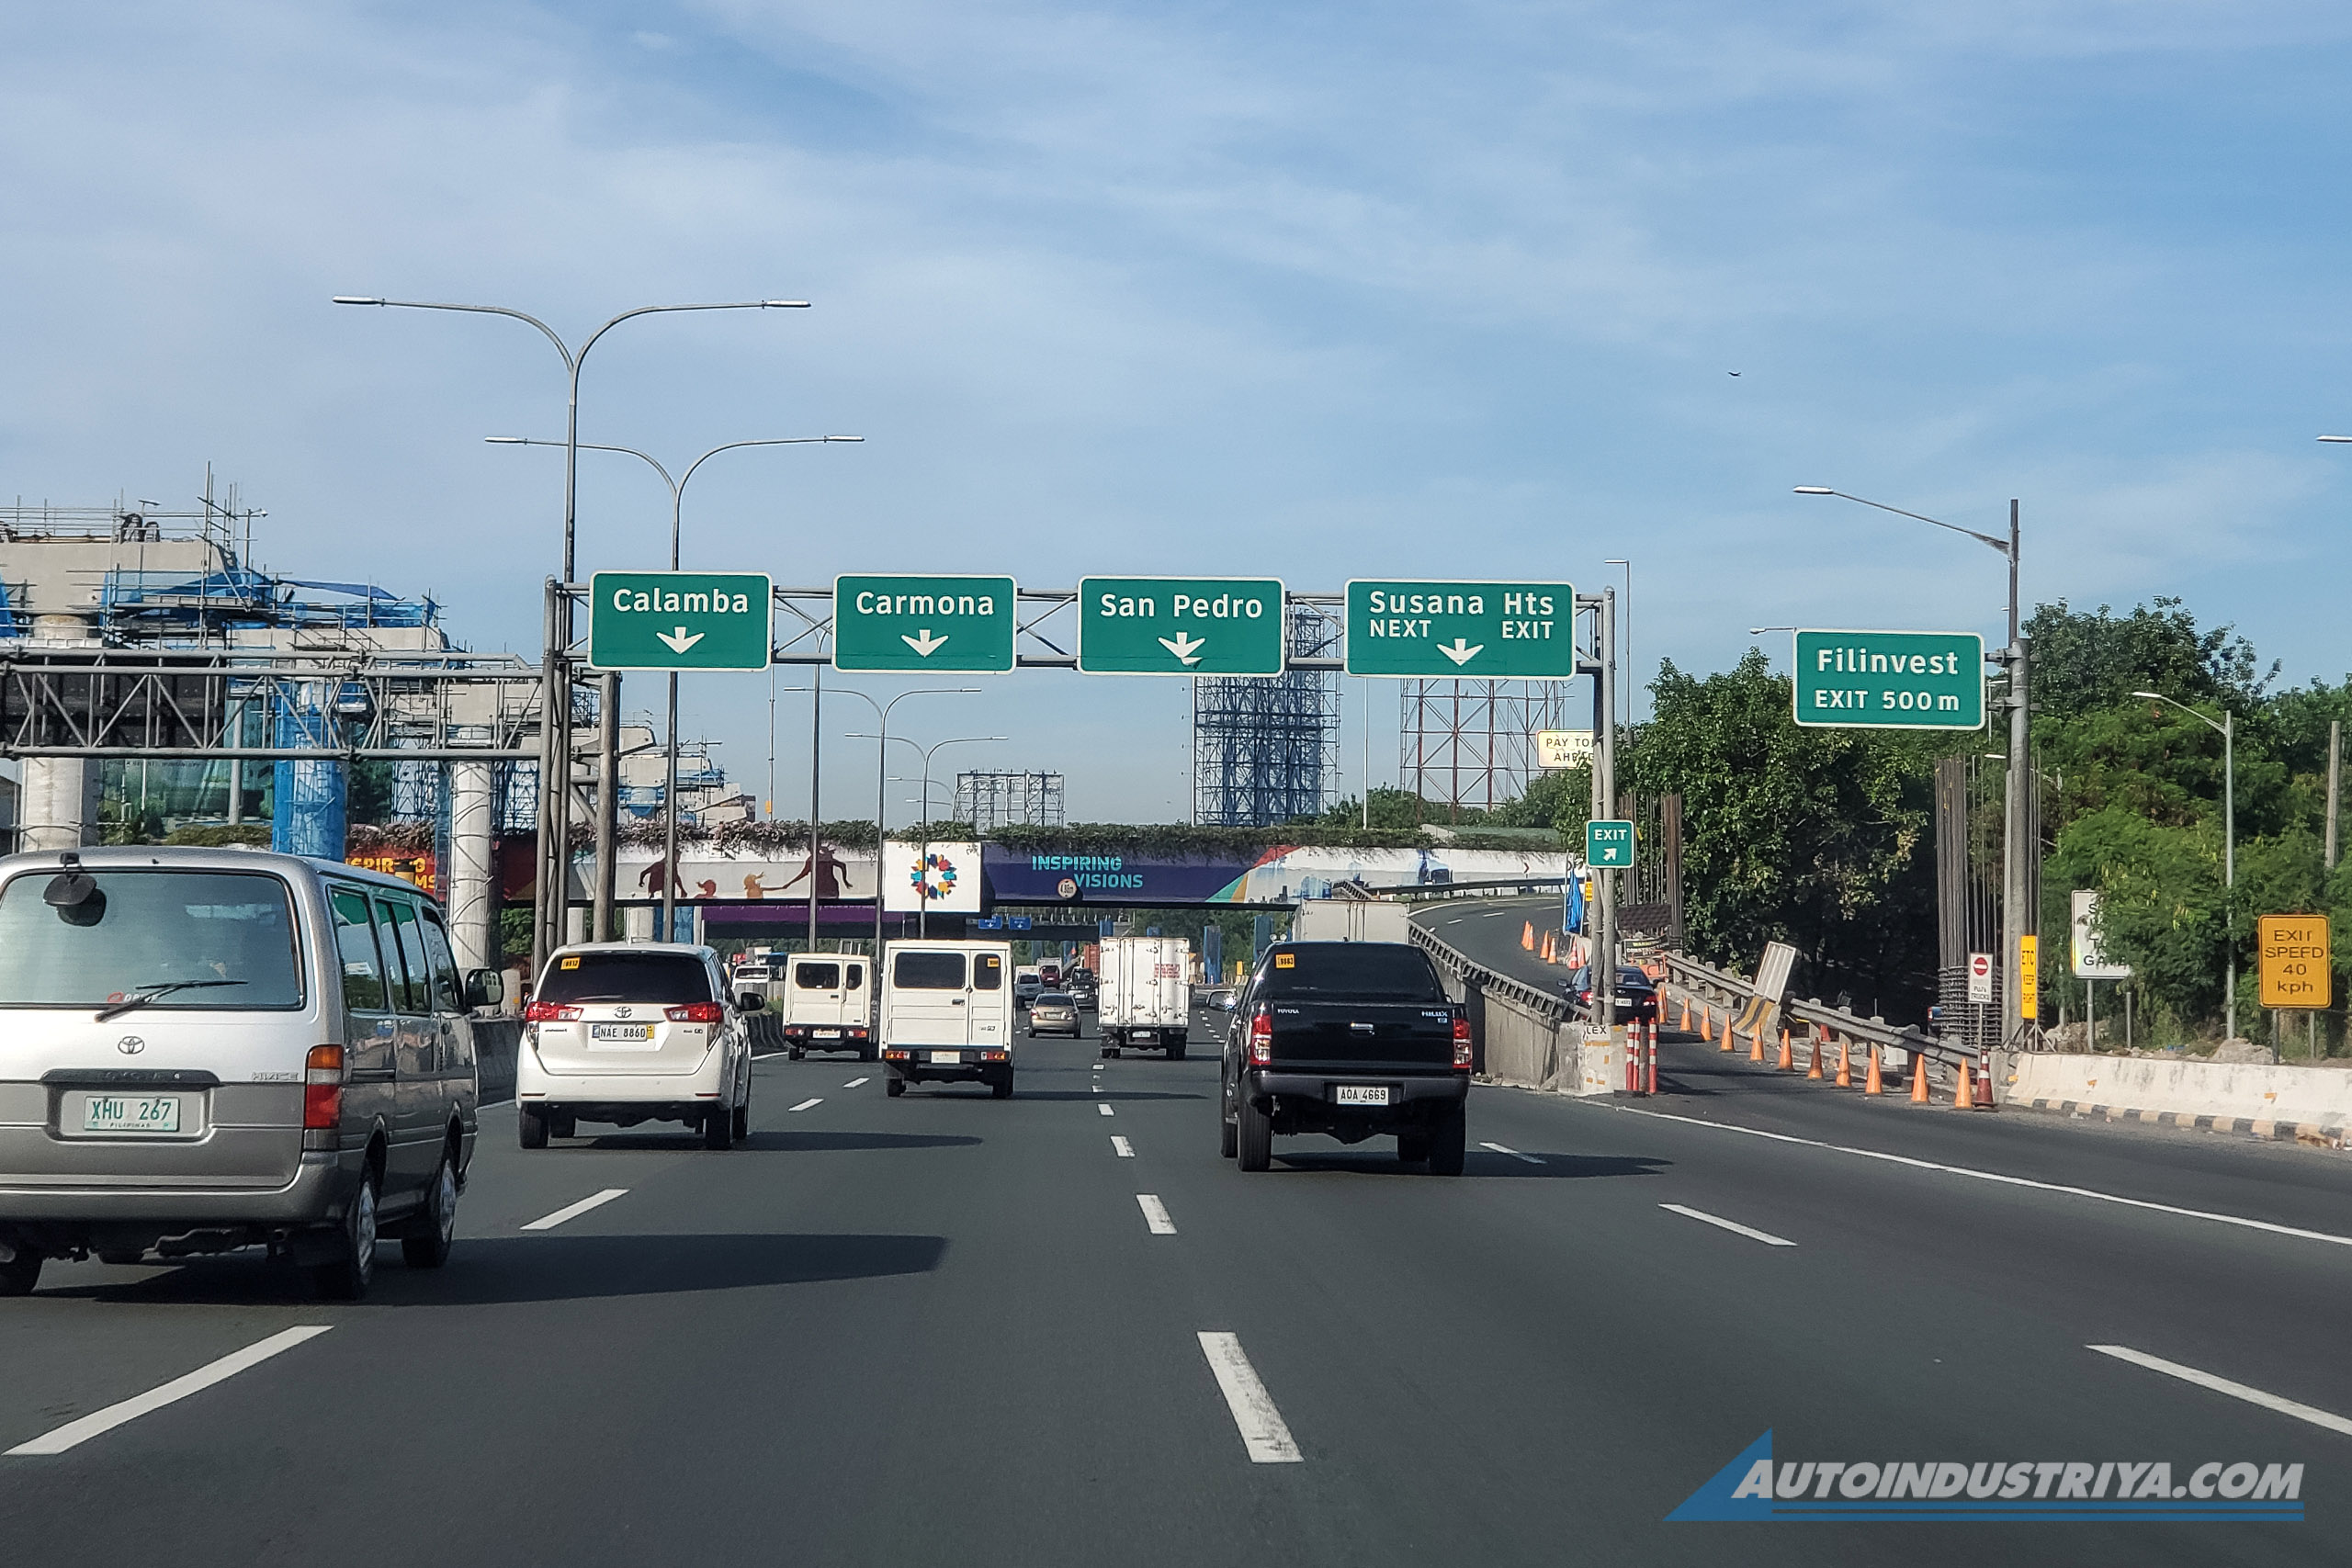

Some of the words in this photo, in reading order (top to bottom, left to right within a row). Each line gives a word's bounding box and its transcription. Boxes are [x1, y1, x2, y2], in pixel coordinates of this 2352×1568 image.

[613, 587, 749, 613] Calamba
[856, 592, 994, 615] Carmona
[1101, 593, 1155, 617] San
[1174, 593, 1262, 618] Pedro
[1370, 591, 1484, 615] Susana
[1504, 592, 1554, 615] Hts
[1370, 619, 1431, 638] NEXT
[1502, 620, 1554, 639] EXIT
[1818, 648, 1959, 675] Filinvest
[1815, 689, 1869, 709] EXIT
[1883, 691, 1932, 710] 500
[1546, 738, 1568, 747] PAY
[1575, 738, 1594, 748] TO
[1594, 829, 1628, 841] EXIT
[1032, 855, 1122, 872] INSPIRING
[1074, 874, 1144, 888] VISIONS
[2274, 930, 2313, 942] EXIT
[2265, 946, 2324, 958] SPEED
[2283, 964, 2307, 976] 40
[2278, 980, 2313, 995] kph
[600, 1028, 617, 1038] NAE
[251, 1072, 299, 1081] HIACE
[1340, 1089, 1359, 1100] AOA
[1362, 1089, 1386, 1100] 4669
[91, 1101, 124, 1120] XHU
[139, 1101, 173, 1121] 267
